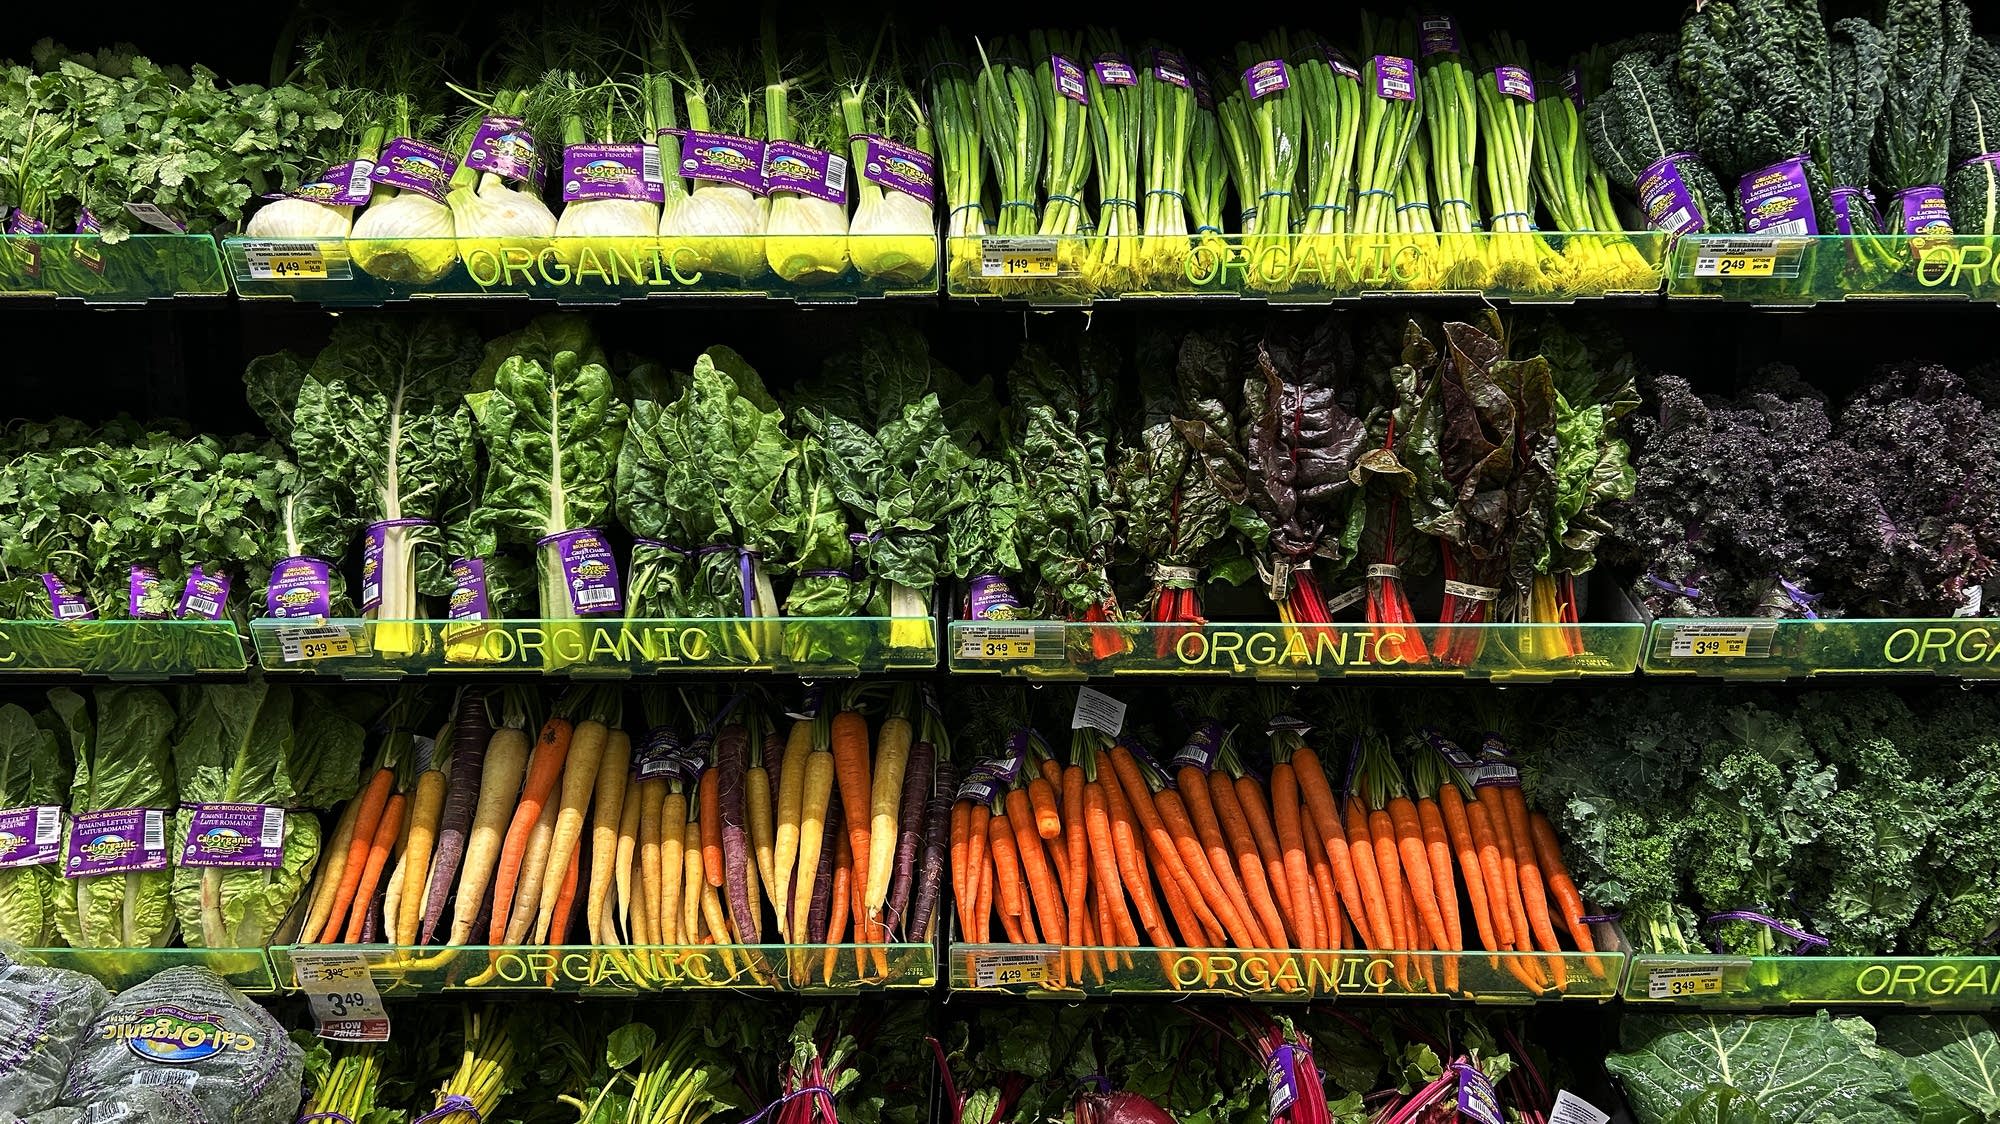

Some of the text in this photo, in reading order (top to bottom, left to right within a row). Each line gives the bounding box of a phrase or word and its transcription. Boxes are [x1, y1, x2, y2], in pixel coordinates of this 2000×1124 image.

[466, 247, 702, 287] ORGANIC
[1184, 243, 1424, 286] ORGANIC
[483, 627, 711, 662] ORGANIC
[1176, 632, 1406, 666] ORGANIC
[77, 817, 139, 830] ROMAINE LETTUCE
[102, 809, 139, 818] BIOLOGIQUE
[224, 812, 258, 821] LETTUCE
[103, 824, 135, 833] ROMAINE
[196, 834, 254, 846] Cal-Organic
[495, 953, 714, 982] ORGANIC
[1172, 956, 1395, 988] ORGANIC
[327, 992, 364, 1017] 349
[340, 1021, 361, 1030] LOW
